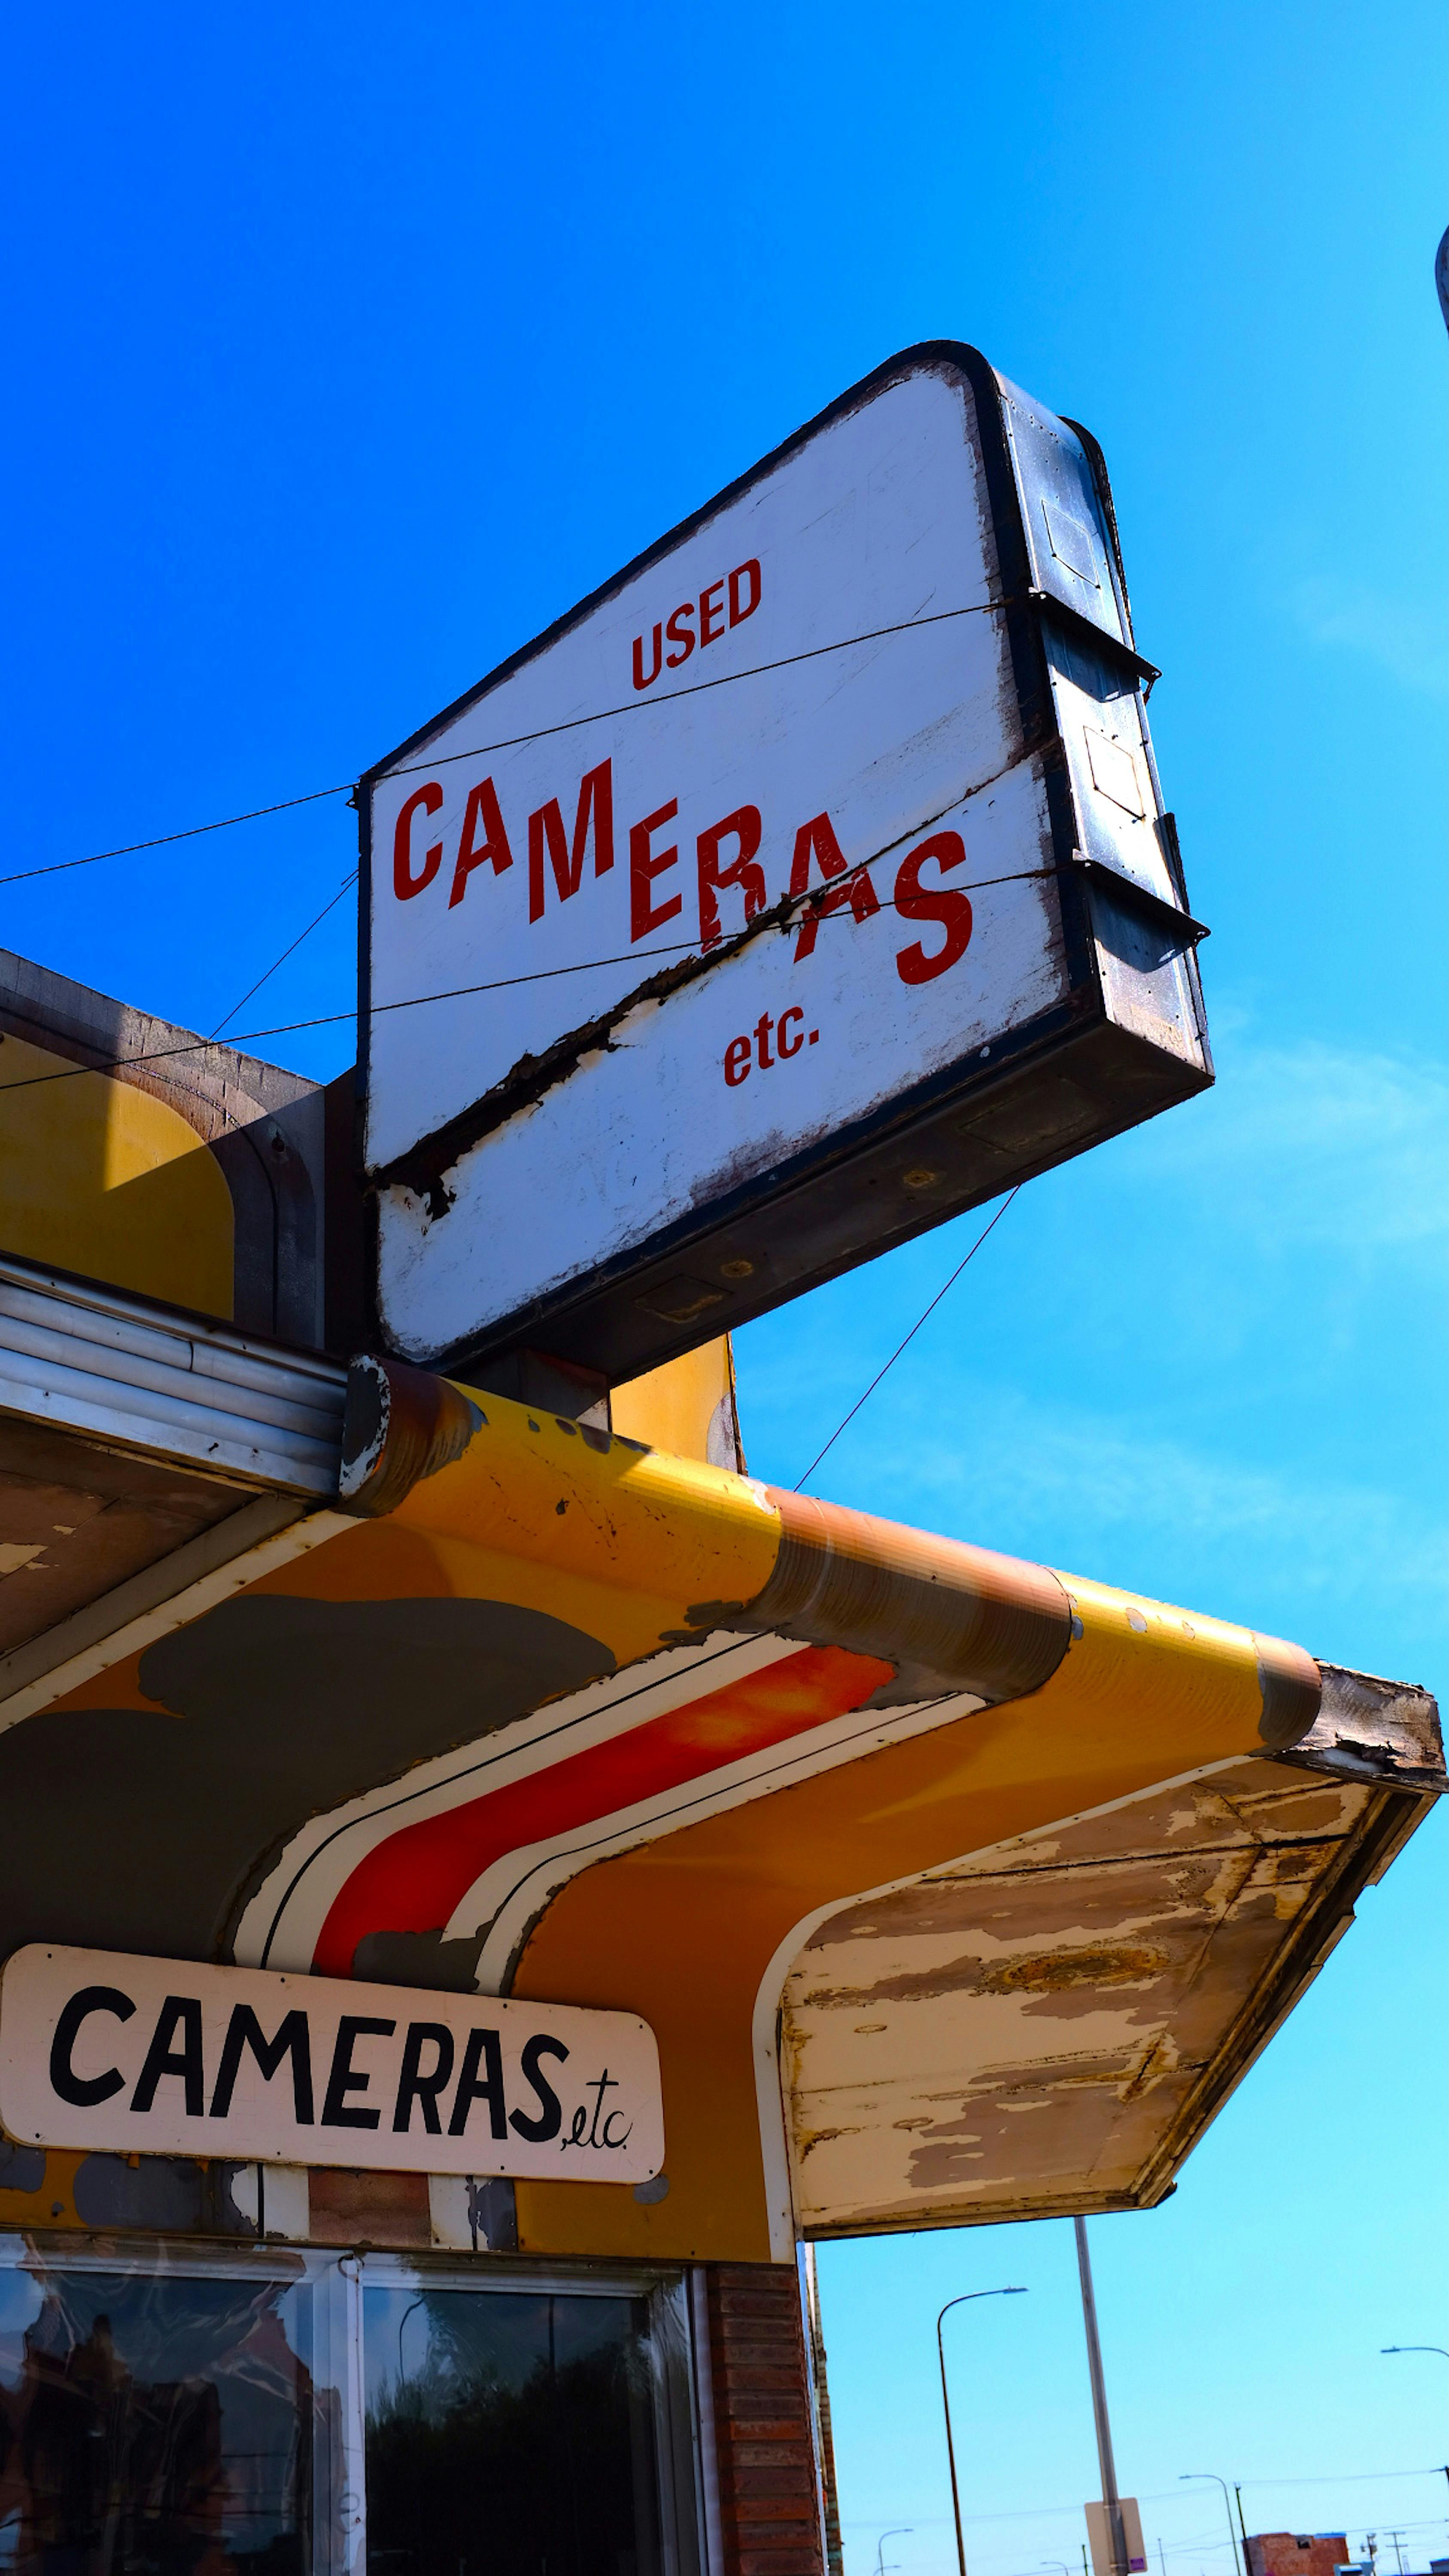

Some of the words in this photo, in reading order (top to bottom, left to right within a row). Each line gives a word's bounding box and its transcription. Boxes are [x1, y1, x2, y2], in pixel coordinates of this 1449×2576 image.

[632, 559, 762, 690] USED
[393, 757, 973, 985] CAMERAS
[724, 1006, 820, 1087] etc.
[49, 1986, 570, 2142] CAMERAS
